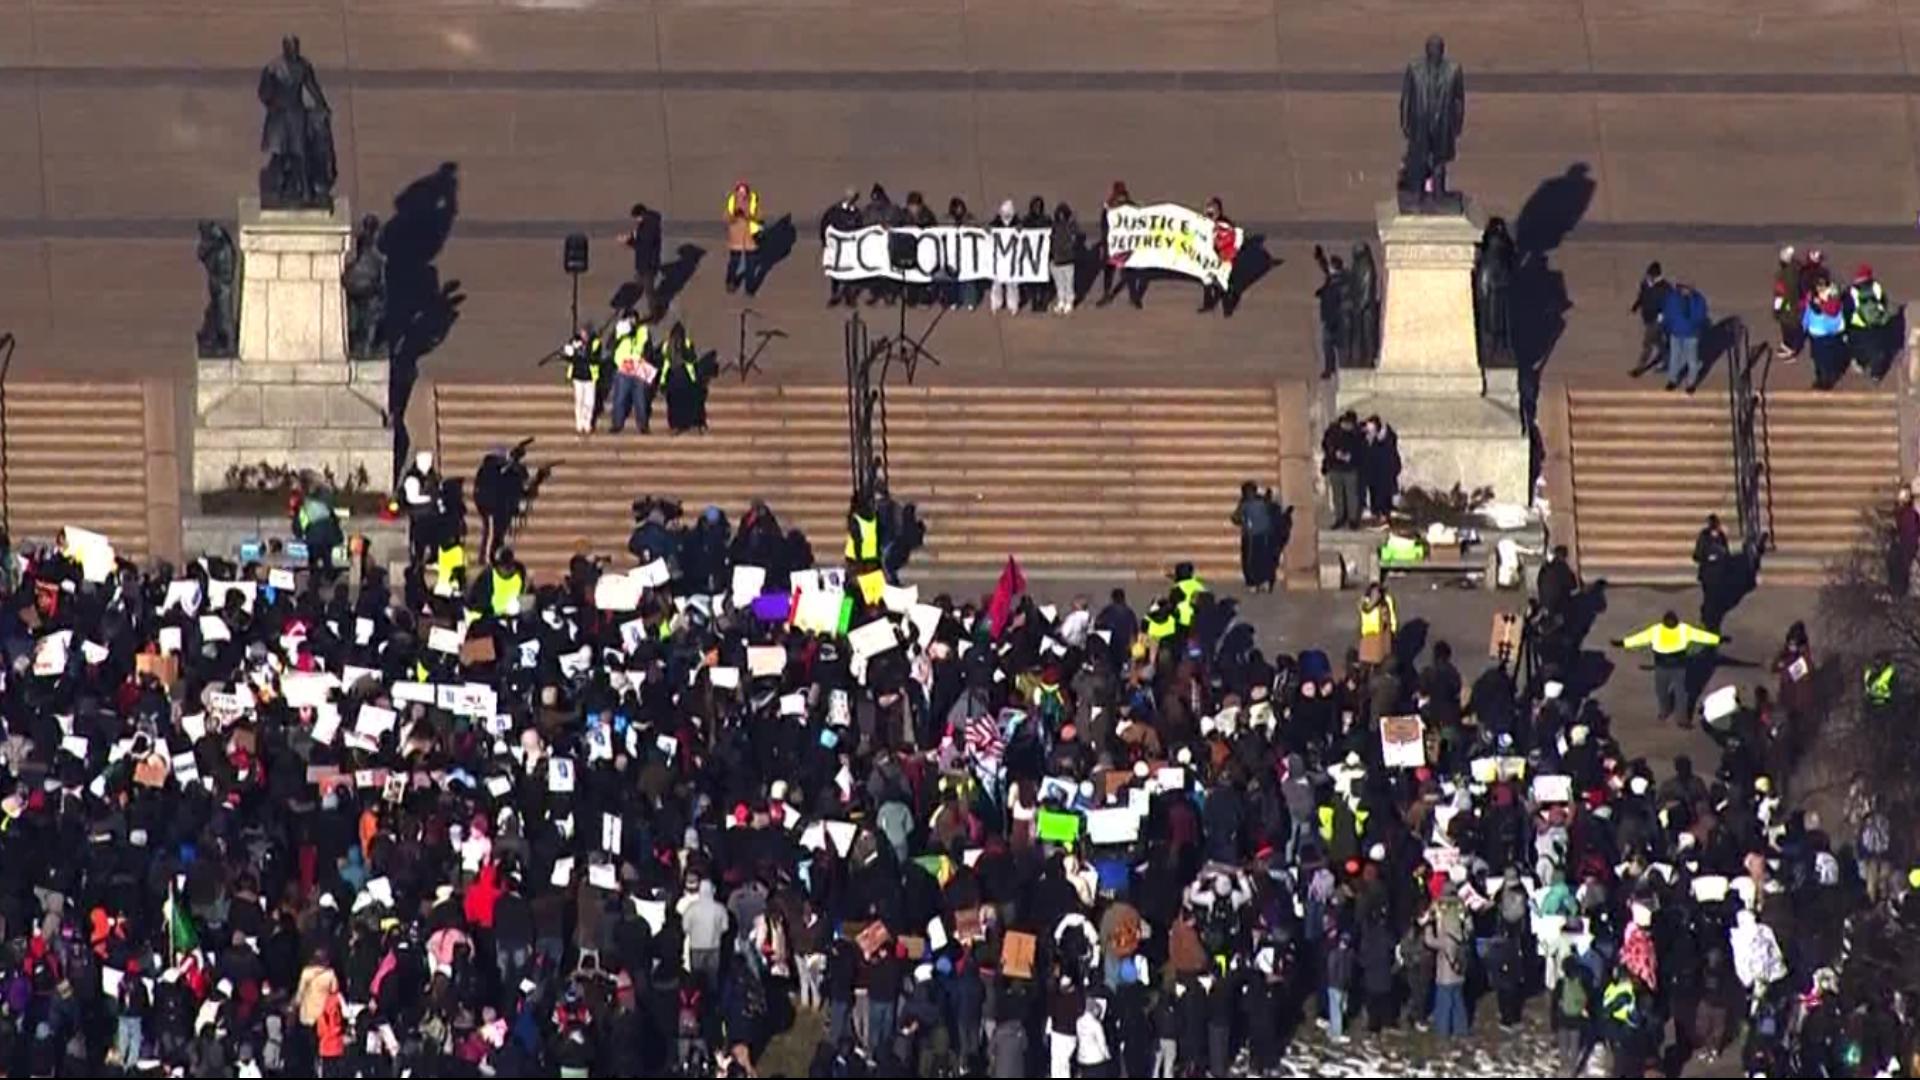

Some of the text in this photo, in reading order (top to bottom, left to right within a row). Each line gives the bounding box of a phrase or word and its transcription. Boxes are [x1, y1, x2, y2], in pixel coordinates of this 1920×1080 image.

[1114, 213, 1190, 235] JUSTICE
[828, 230, 1045, 277] IC OUT MN
